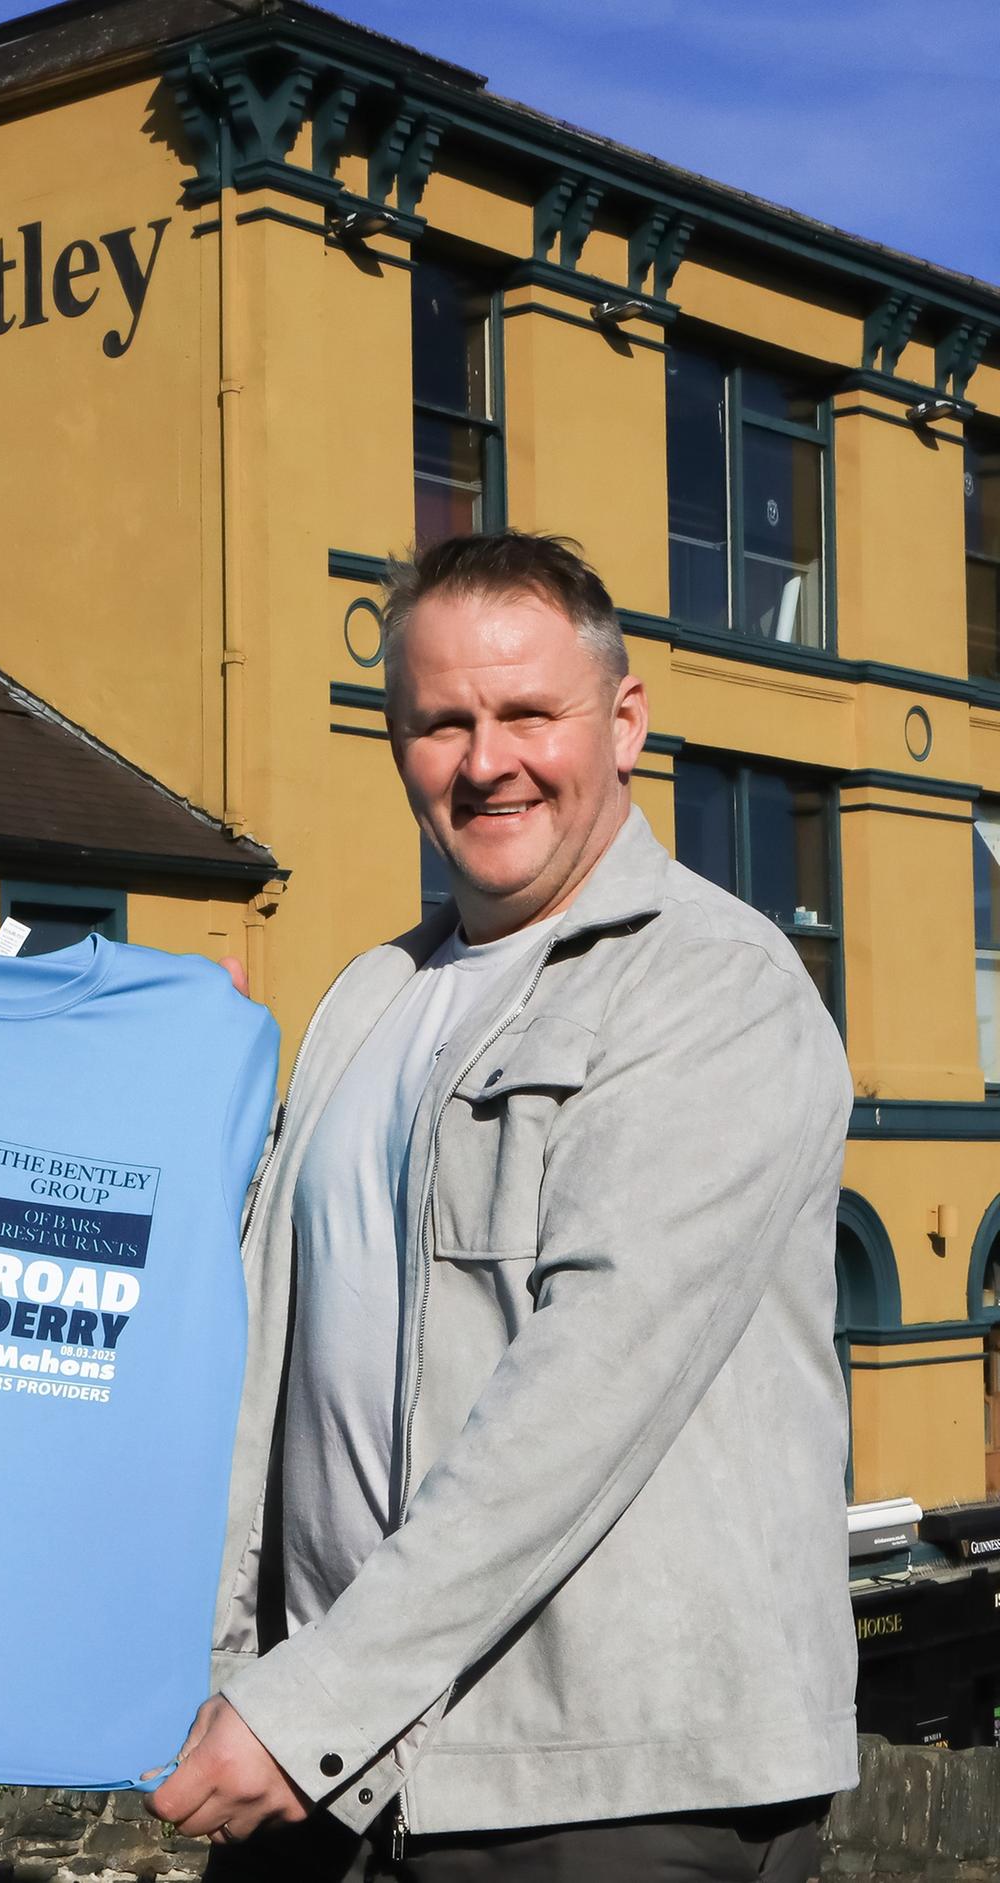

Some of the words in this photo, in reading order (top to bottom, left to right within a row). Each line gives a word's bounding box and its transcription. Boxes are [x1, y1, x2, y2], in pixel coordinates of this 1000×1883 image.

[48, 1158, 151, 1190] BENTLEY
[30, 1177, 110, 1205] GROUP
[24, 1208, 51, 1226] OF
[53, 1214, 102, 1235] BARS
[0, 1222, 139, 1257] RESTAURANTS
[60, 1345, 116, 1362] 08.03.2025
[16, 1379, 111, 1403] PROVIDERS
[858, 1613, 903, 1640] HOUSE
